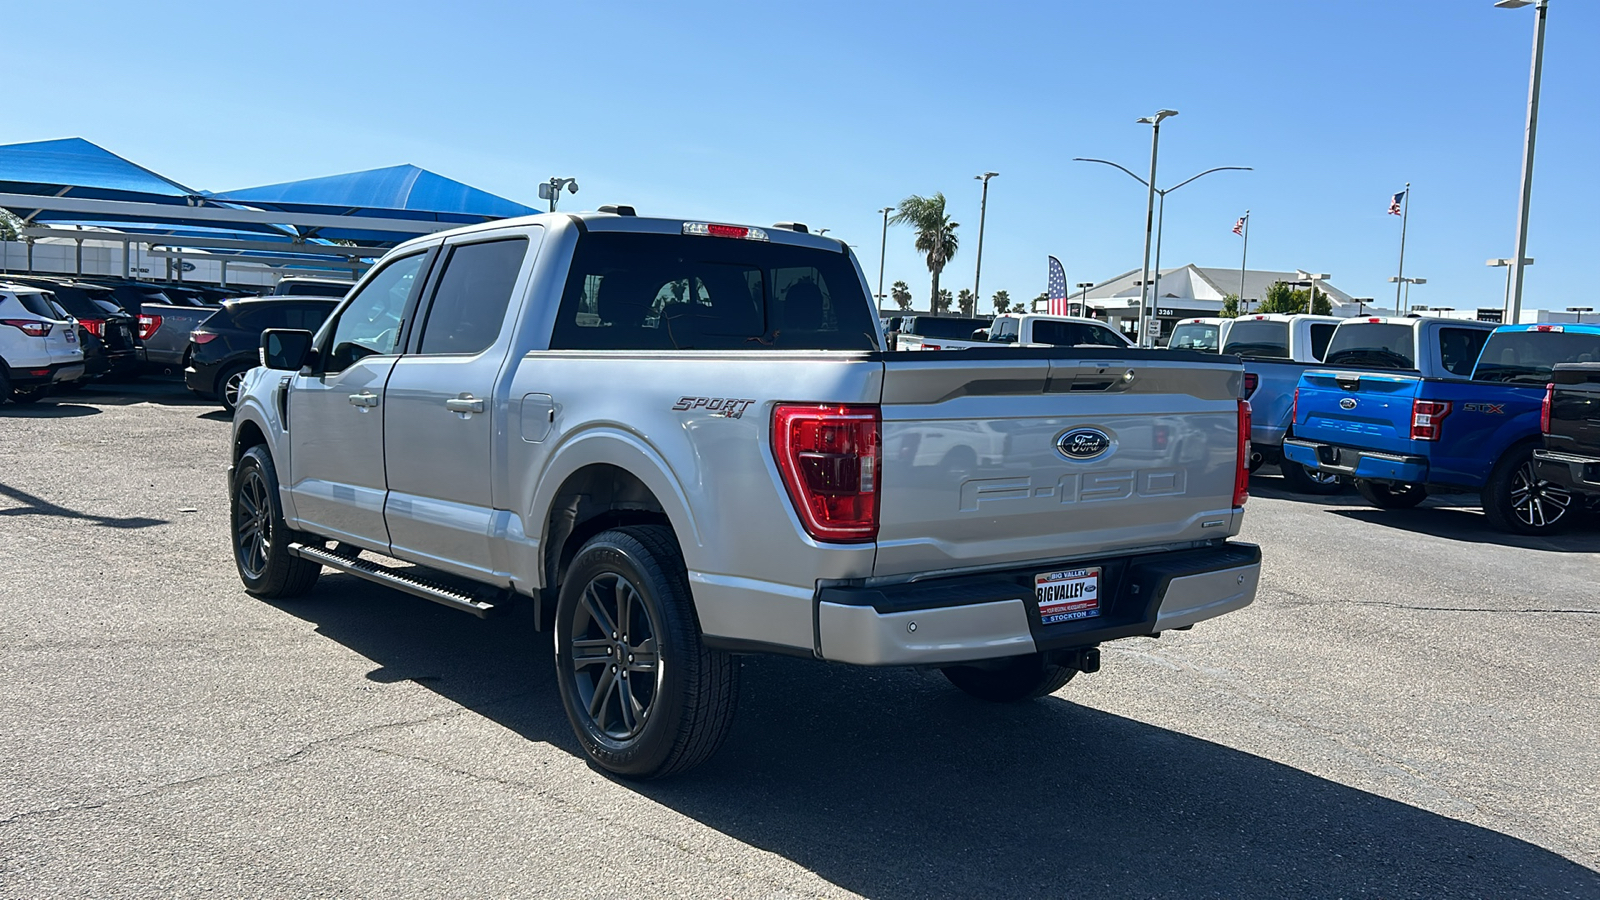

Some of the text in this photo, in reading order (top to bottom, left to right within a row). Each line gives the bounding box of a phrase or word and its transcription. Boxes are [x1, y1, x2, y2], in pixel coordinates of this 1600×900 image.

[1158, 308, 1174, 316] 3261
[672, 396, 757, 412] SPORT
[1462, 402, 1506, 415] STX
[1072, 434, 1100, 452] Ford
[959, 467, 1188, 513] F-150
[1064, 570, 1086, 578] VALLEY
[1037, 582, 1086, 603] BIGVALLEY
[1050, 611, 1087, 622] STOCKTON
